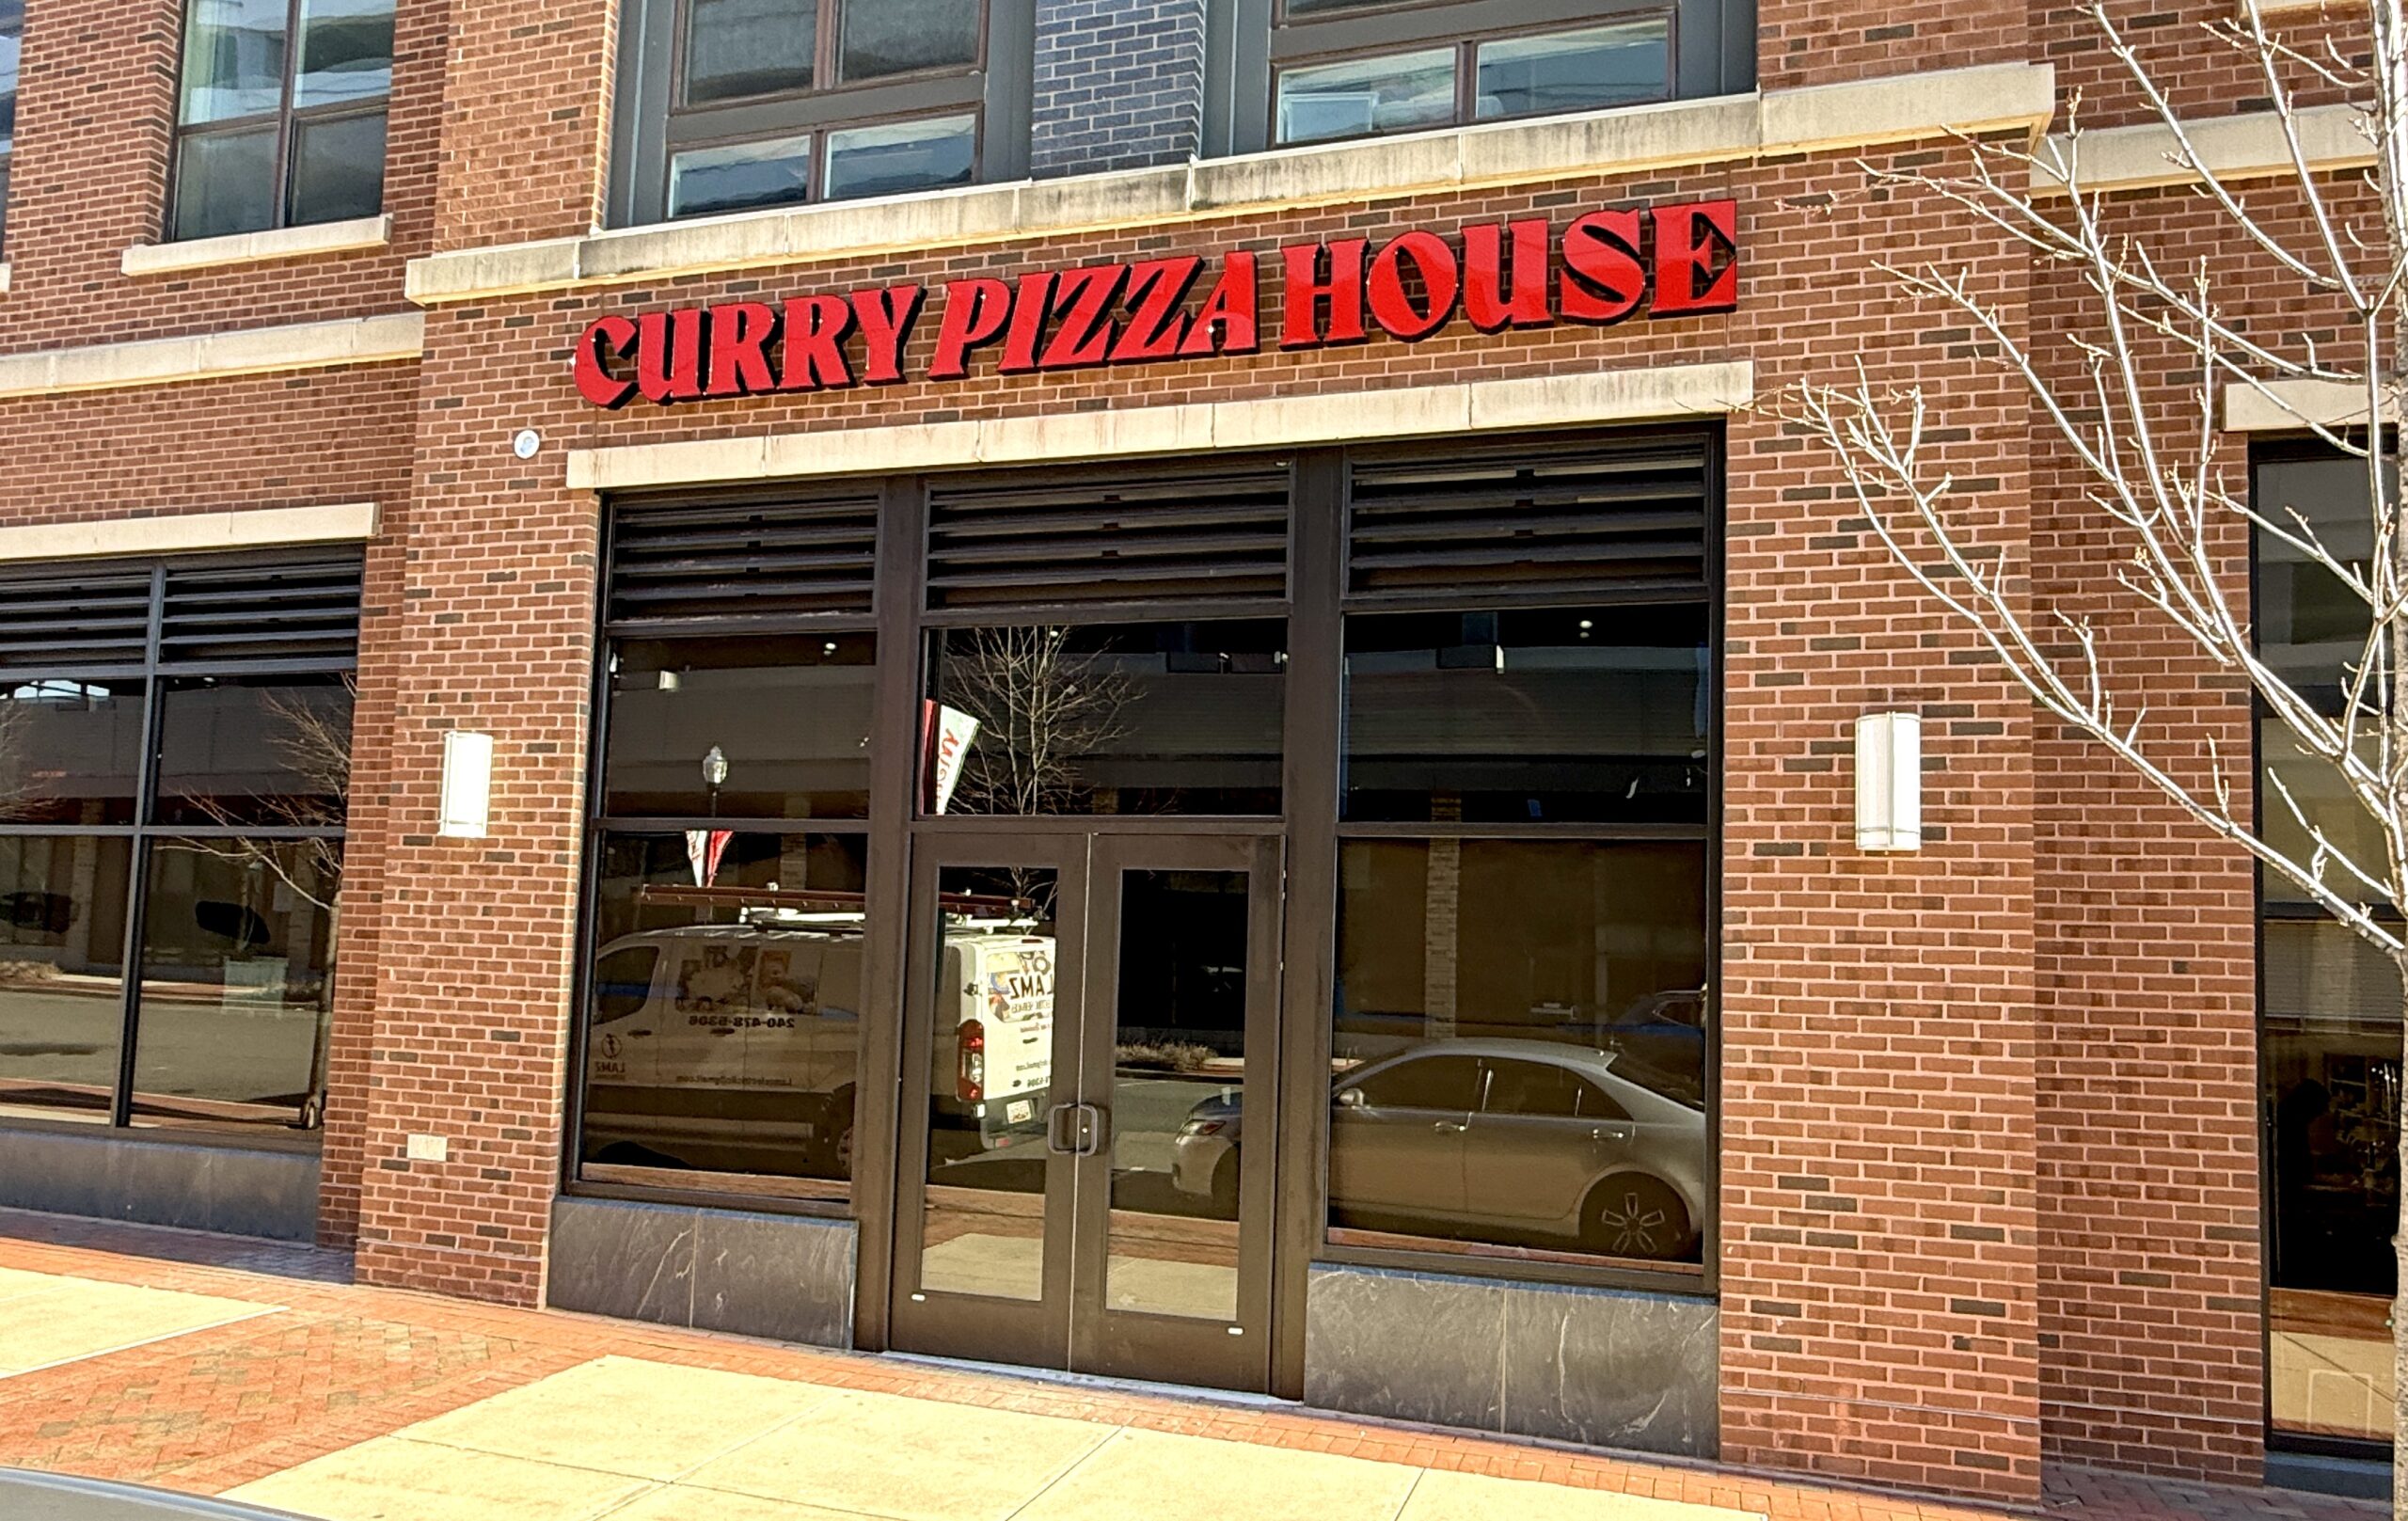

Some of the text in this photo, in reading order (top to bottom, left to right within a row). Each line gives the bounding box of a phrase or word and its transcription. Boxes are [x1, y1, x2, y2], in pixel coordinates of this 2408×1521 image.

[573, 199, 1738, 410] CURRY PIZZA HOUSE
